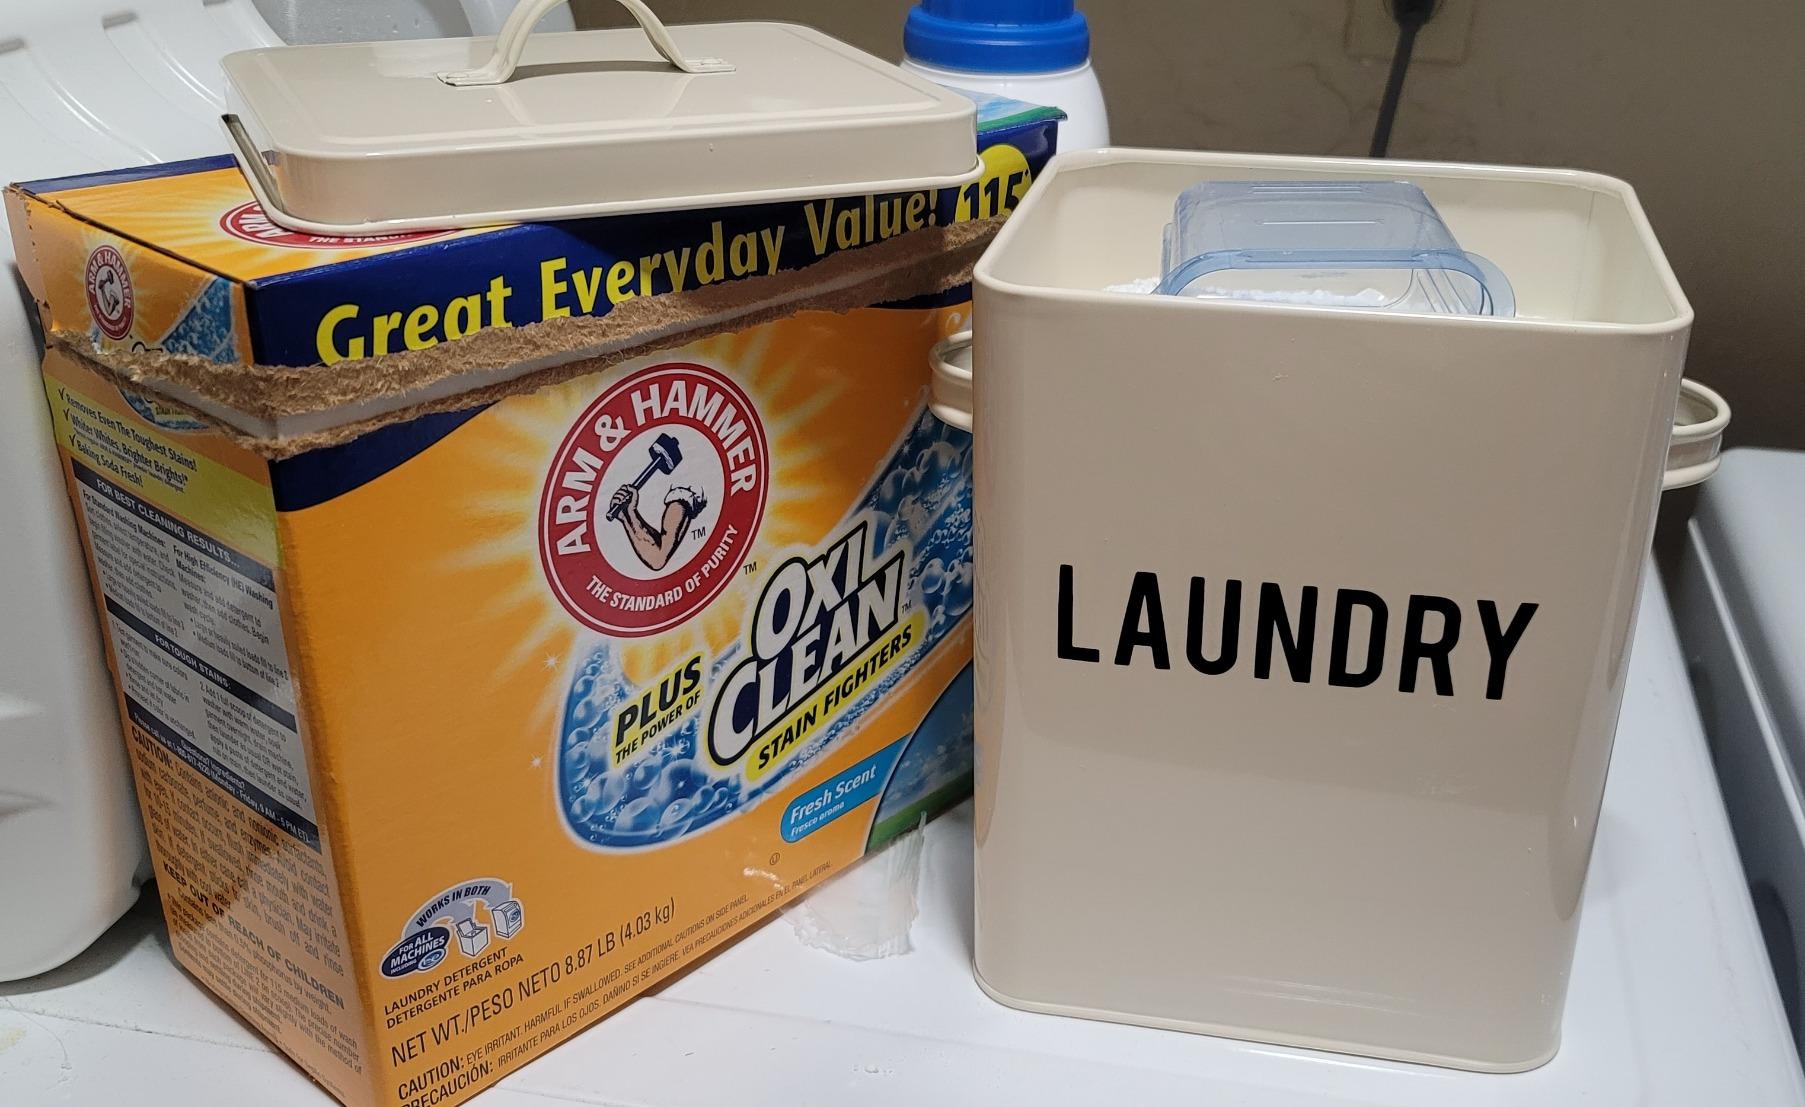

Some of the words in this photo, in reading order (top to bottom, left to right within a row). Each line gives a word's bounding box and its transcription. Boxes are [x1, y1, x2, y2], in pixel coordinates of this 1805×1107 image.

[88, 260, 99, 294] ARM
[104, 250, 132, 309] HAMMER
[316, 275, 512, 366] Great
[540, 221, 785, 321] Everyday
[804, 188, 938, 255] Value!
[65, 392, 97, 420] Removes
[96, 408, 116, 431] Even
[115, 419, 131, 438] The
[130, 427, 168, 461] Toughest
[167, 445, 198, 474] Stains!
[70, 413, 93, 436] Whiter
[120, 440, 153, 471] Brighter
[76, 439, 101, 466] Baking
[99, 453, 120, 475] Soda
[119, 464, 144, 489] Fresh!
[556, 446, 604, 556] ARM
[594, 415, 631, 451] &
[630, 380, 757, 496] HAMMER
[96, 477, 113, 497] FOR
[113, 488, 136, 510] BEST
[137, 501, 185, 538] CLEANING
[185, 527, 240, 569] RESULTS...
[171, 541, 183, 559] For
[182, 548, 199, 570] High
[197, 556, 230, 588] Efficiency
[244, 582, 274, 612] Washing
[174, 556, 206, 585] Machines:
[586, 575, 613, 603] THE
[610, 585, 683, 611] STANDARD
[685, 575, 702, 593] OF
[700, 524, 739, 578] PURITY
[743, 561, 757, 576] TM
[752, 520, 867, 660] OXI
[154, 633, 170, 651] FOR
[169, 643, 197, 668] TOUGH
[198, 661, 230, 690] STAINS:
[708, 550, 905, 765] CLEAN
[1057, 564, 1539, 700] LAUNDRY
[615, 655, 701, 747] PLUS
[615, 742, 638, 765] THE
[641, 706, 683, 747] POWER
[685, 690, 701, 713] OF
[758, 706, 817, 770] STAIN
[824, 624, 912, 712] FIGHTERS
[130, 726, 174, 771] CAUTION:
[789, 789, 832, 825] Fresh
[836, 763, 877, 799] Scent
[819, 800, 845, 822] aroma
[162, 860, 188, 889] KEEP
[188, 882, 210, 909] OUT
[210, 900, 226, 921] OF
[227, 913, 264, 951] REACH
[265, 942, 282, 965] OF
[283, 953, 345, 1012] CHILDREN
[399, 943, 413, 954] FOR
[414, 932, 433, 947] ALL
[416, 895, 450, 927] WORKS
[452, 889, 463, 901] IN
[464, 885, 491, 897] BOTH
[383, 980, 441, 1016] LAUNDRY
[442, 946, 509, 986] DETERGENT
[389, 1030, 430, 1068] NET
[430, 986, 516, 1049] WT./PESO
[516, 960, 562, 1001] NETO
[563, 943, 595, 976] 8.87
[595, 930, 616, 957] LB
[618, 910, 652, 947] (4.03
[652, 896, 676, 928] kg)
[390, 935, 445, 968] MACHINES
[385, 984, 460, 1029] DETERGENTE
[461, 968, 492, 991] PARA
[493, 952, 524, 975] ROPA
[396, 1051, 465, 1103] CAUTION:
[465, 1045, 483, 1065] EYE
[522, 1001, 562, 1032] HARMFUL
[562, 995, 572, 1009] IF
[571, 966, 622, 1004] SWALLOWED.
[623, 958, 637, 974] SEE
[637, 936, 674, 966] ADDITIONAL
[674, 918, 705, 944] CAUTIONS
[705, 912, 715, 925] ON
[714, 904, 729, 919] SIDE
[496, 1035, 539, 1068] IRRITANTE
[539, 1021, 561, 1042] PARA
[561, 1012, 577, 1029] LOS
[601, 977, 631, 1004] DAÑINO
[631, 974, 639, 986] SI
[640, 967, 650, 981] SE
